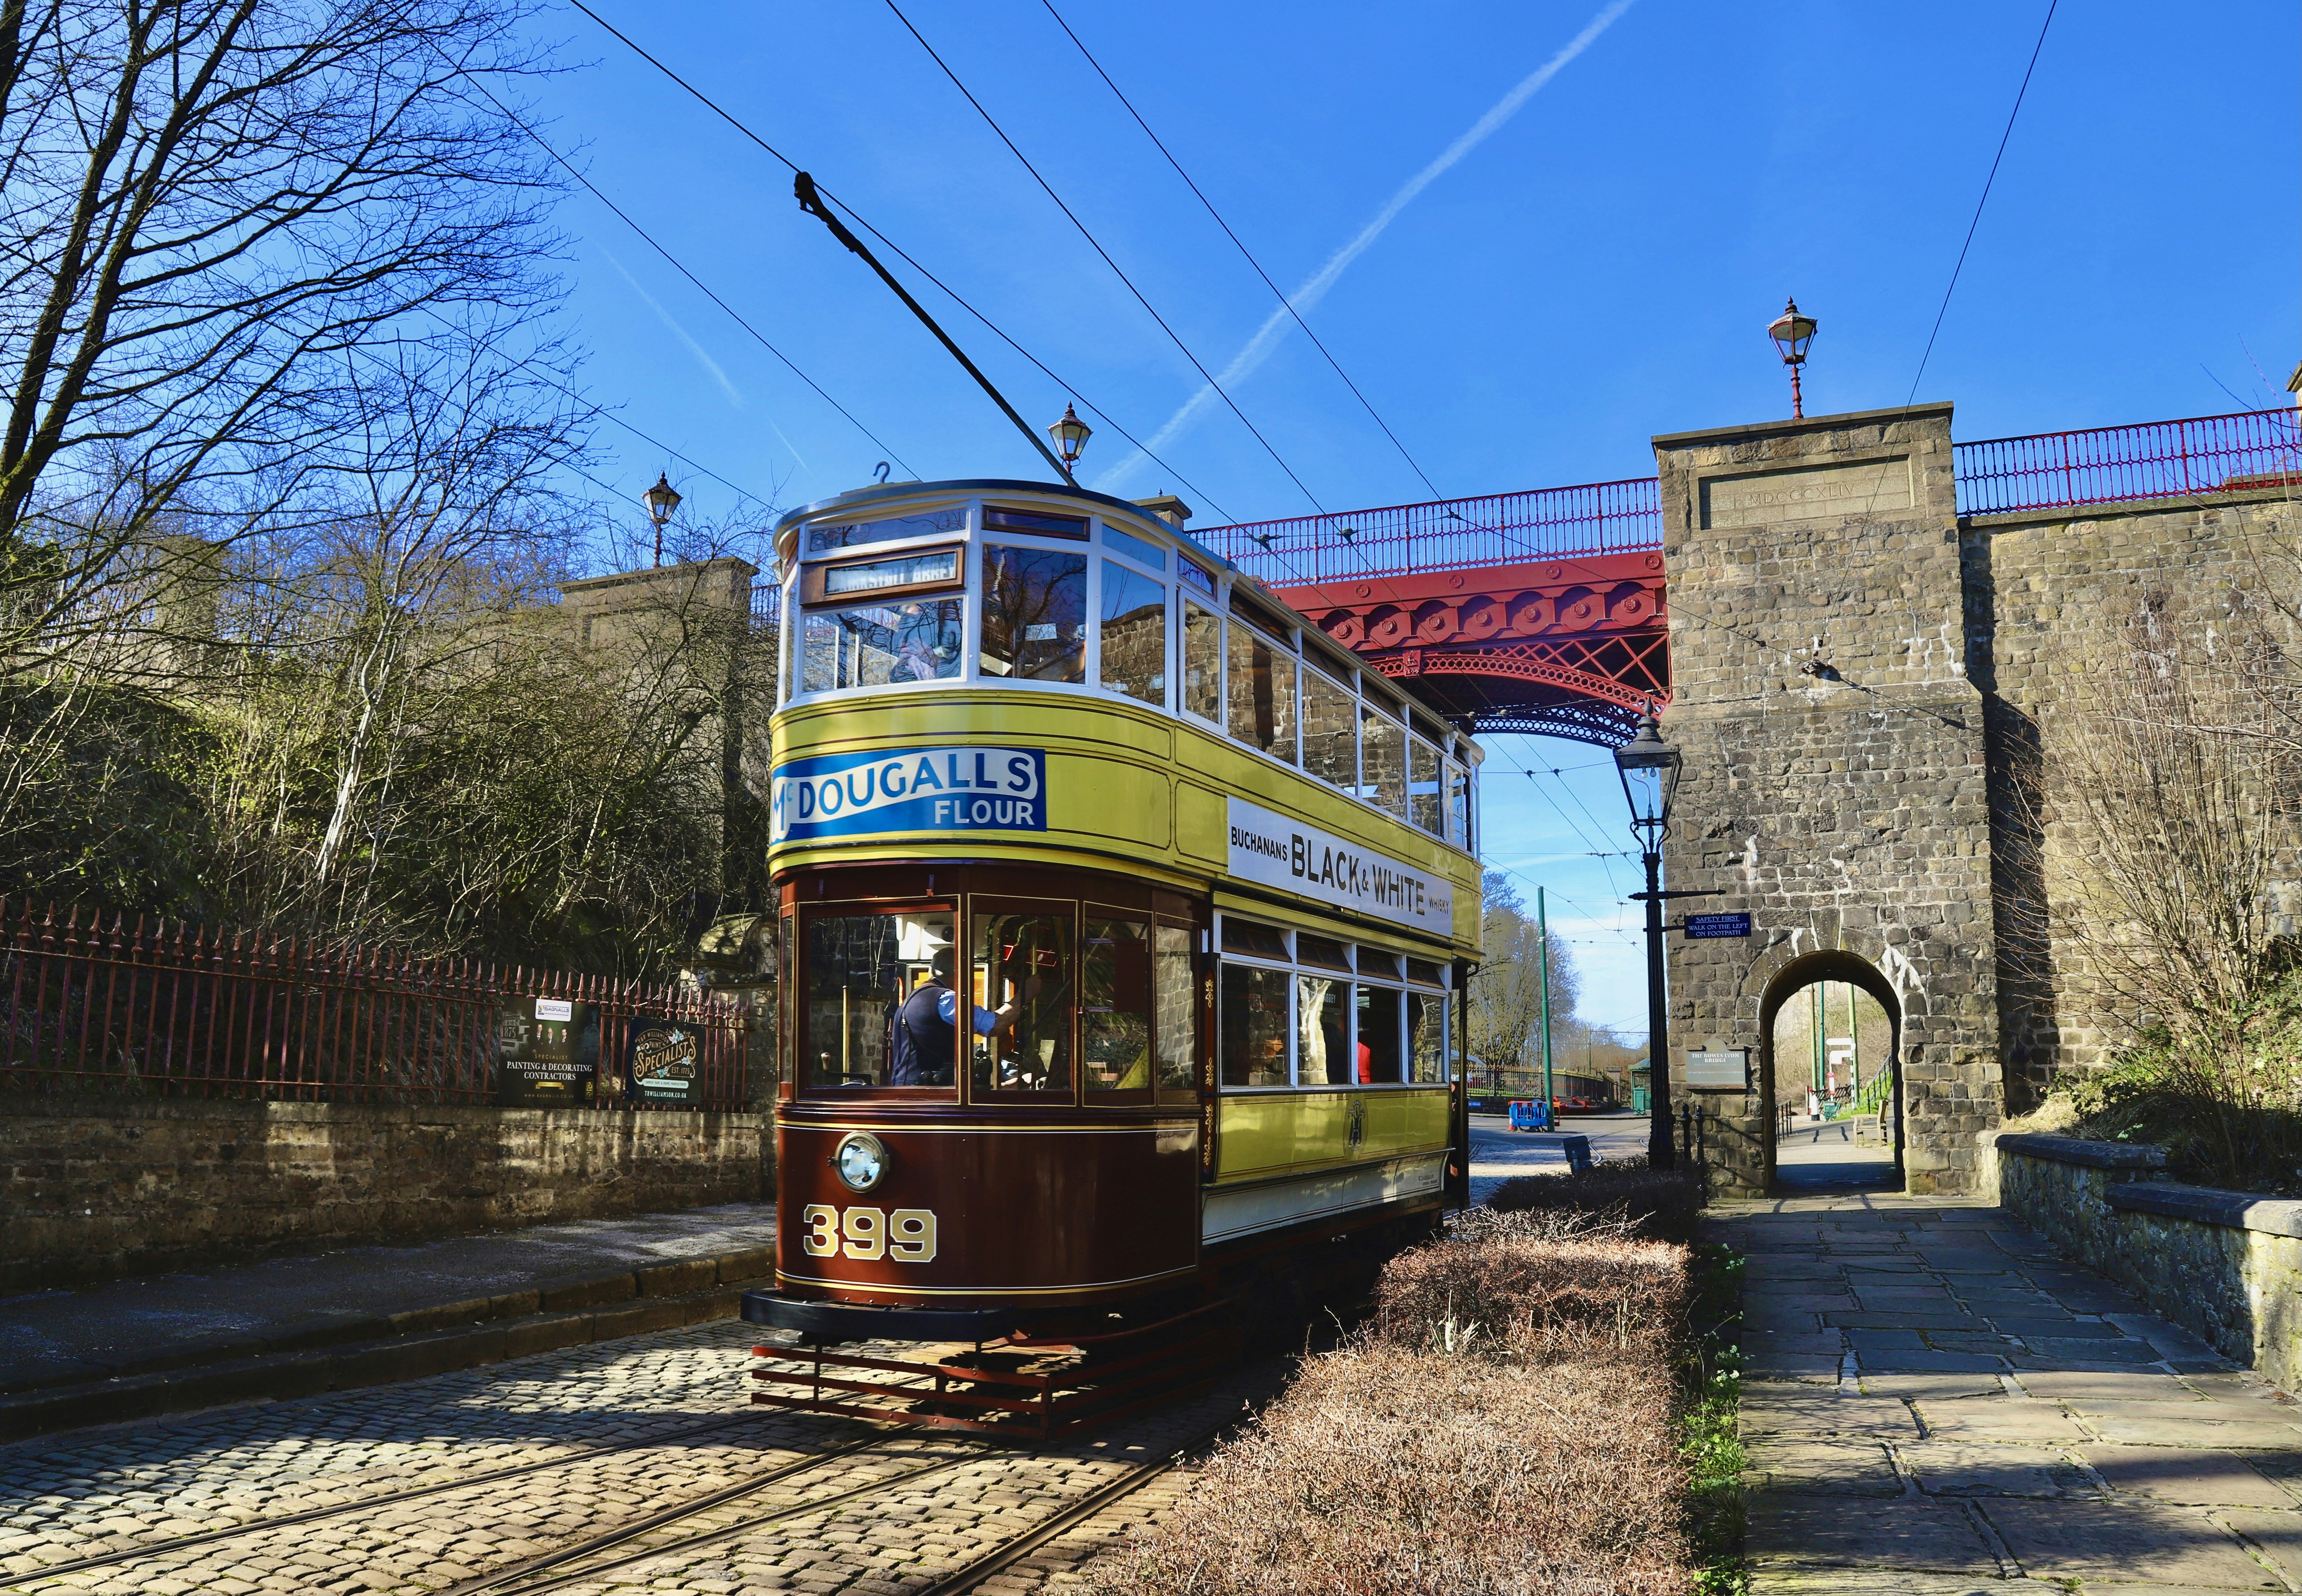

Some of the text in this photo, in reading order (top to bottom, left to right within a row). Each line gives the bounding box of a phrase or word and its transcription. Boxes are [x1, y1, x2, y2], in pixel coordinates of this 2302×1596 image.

[1750, 484, 1855, 505] MDCCCXLIV
[936, 800, 1035, 825] FLOUR
[1231, 826, 1449, 916] BUCHANANS BLACK & WHITE WHISKY
[647, 1031, 669, 1044] WILLIAMSON
[507, 1061, 540, 1070] PAINTING
[549, 1063, 592, 1072] DECORATING
[636, 1036, 696, 1077] SPECIALISTS
[524, 1072, 576, 1080] CONTRACTORS
[804, 1204, 937, 1262] 399
